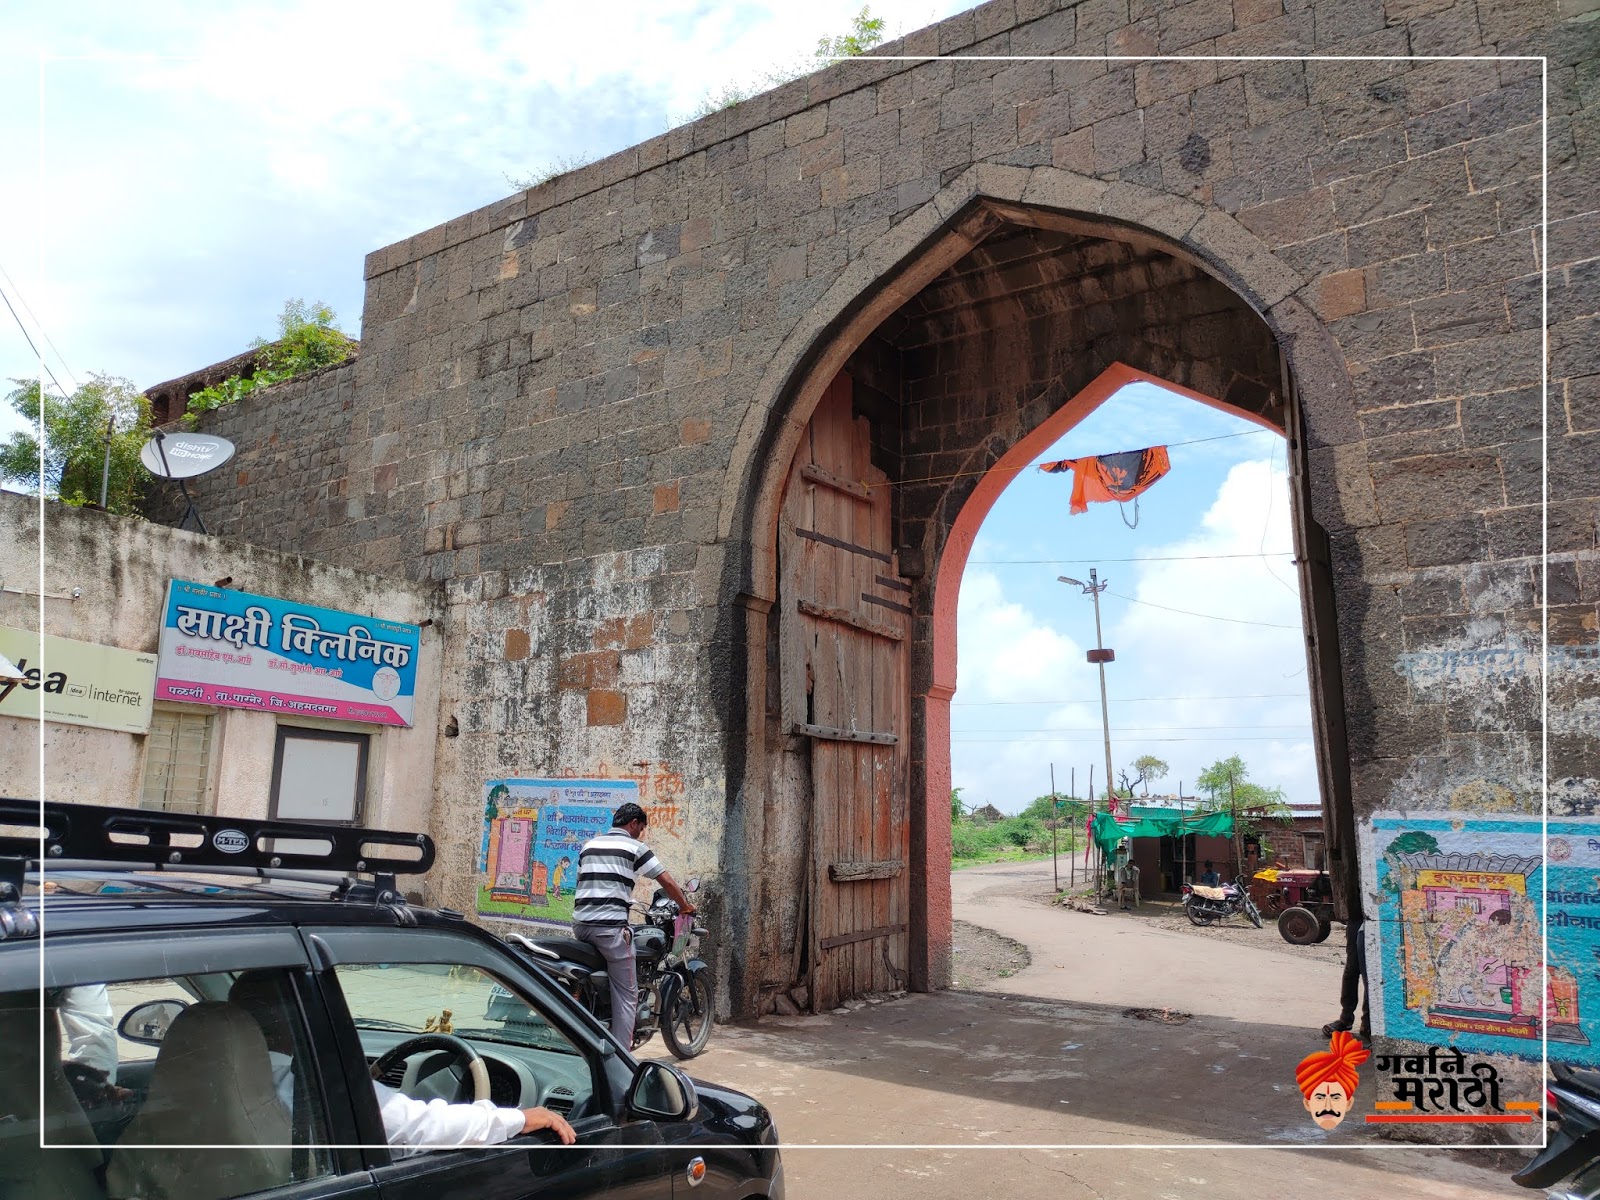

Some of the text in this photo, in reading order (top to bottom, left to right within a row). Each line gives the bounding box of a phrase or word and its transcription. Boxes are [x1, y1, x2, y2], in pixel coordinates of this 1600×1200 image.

[176, 606, 413, 669] साक्षी क्लिनिक
[93, 687, 142, 707] internet
[217, 837, 246, 846] M-TEK
